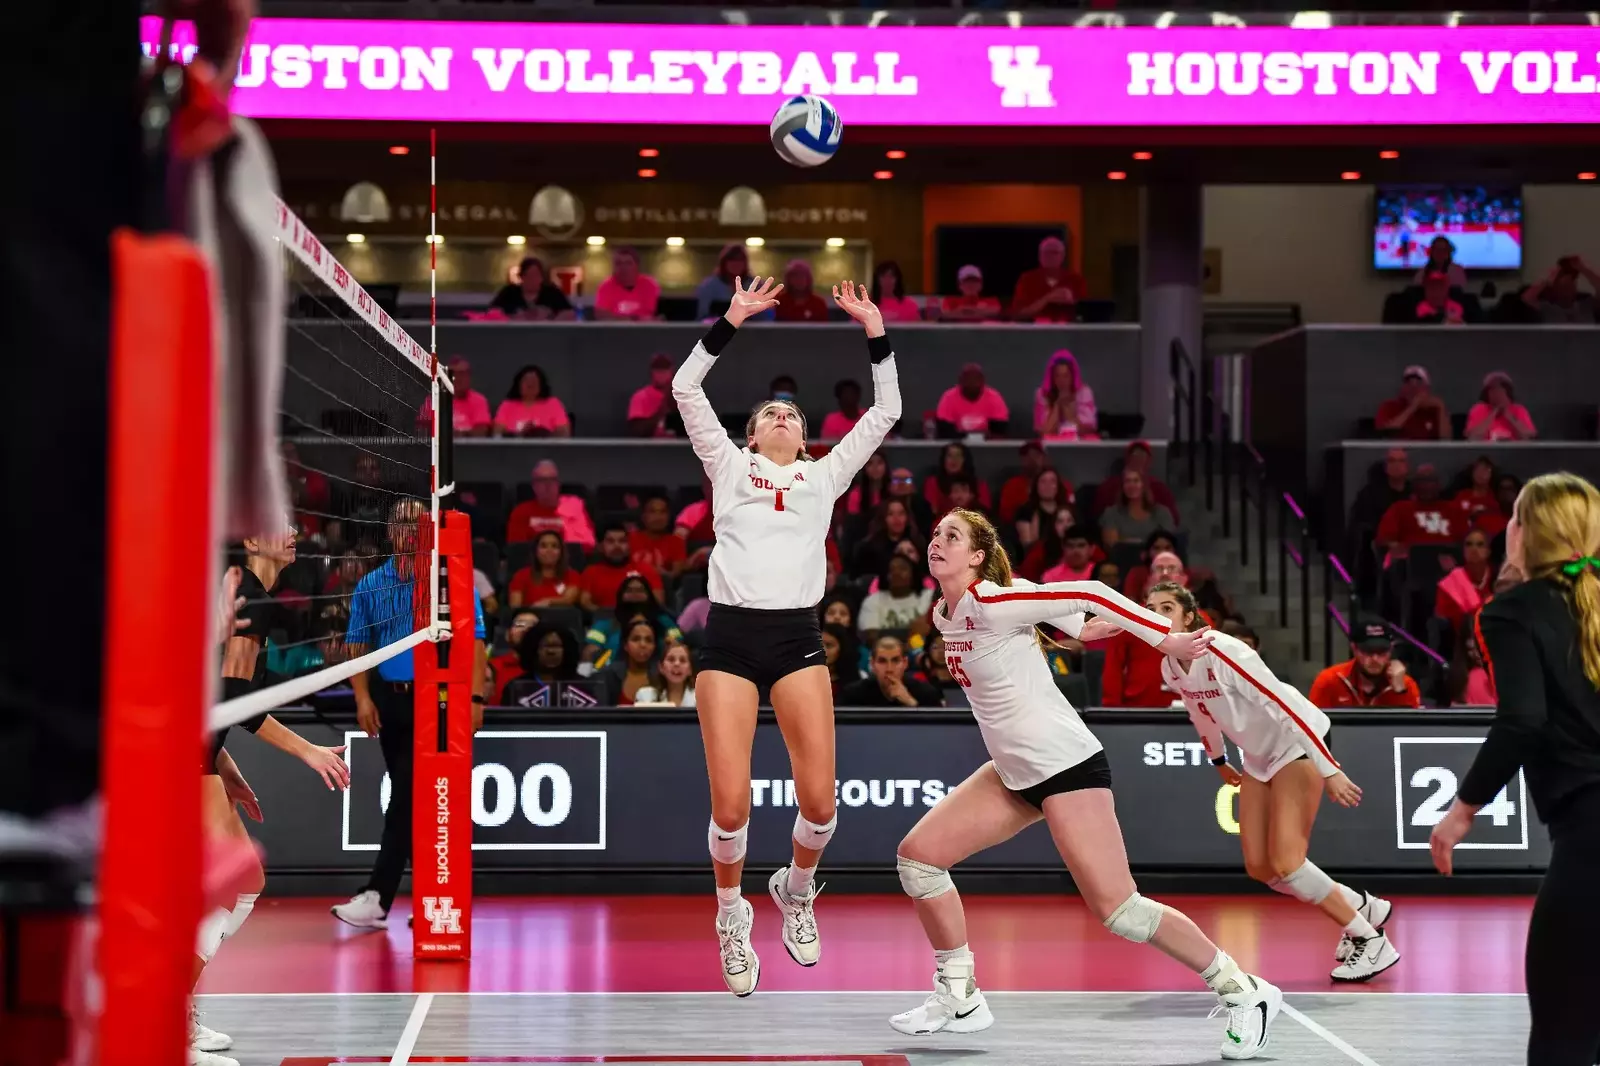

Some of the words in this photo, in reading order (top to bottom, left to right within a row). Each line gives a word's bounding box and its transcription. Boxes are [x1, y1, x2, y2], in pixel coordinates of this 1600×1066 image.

[234, 44, 452, 90] USTON
[474, 48, 917, 95] VOLLEYBALL
[1128, 52, 1439, 95] HOUSTON
[1461, 51, 1600, 94] VOL
[947, 656, 972, 688] 25
[1143, 742, 1226, 766] SET
[434, 777, 450, 824] sports
[751, 780, 954, 807] TIOUTS
[434, 826, 450, 885] imports
[422, 897, 462, 934] UH
